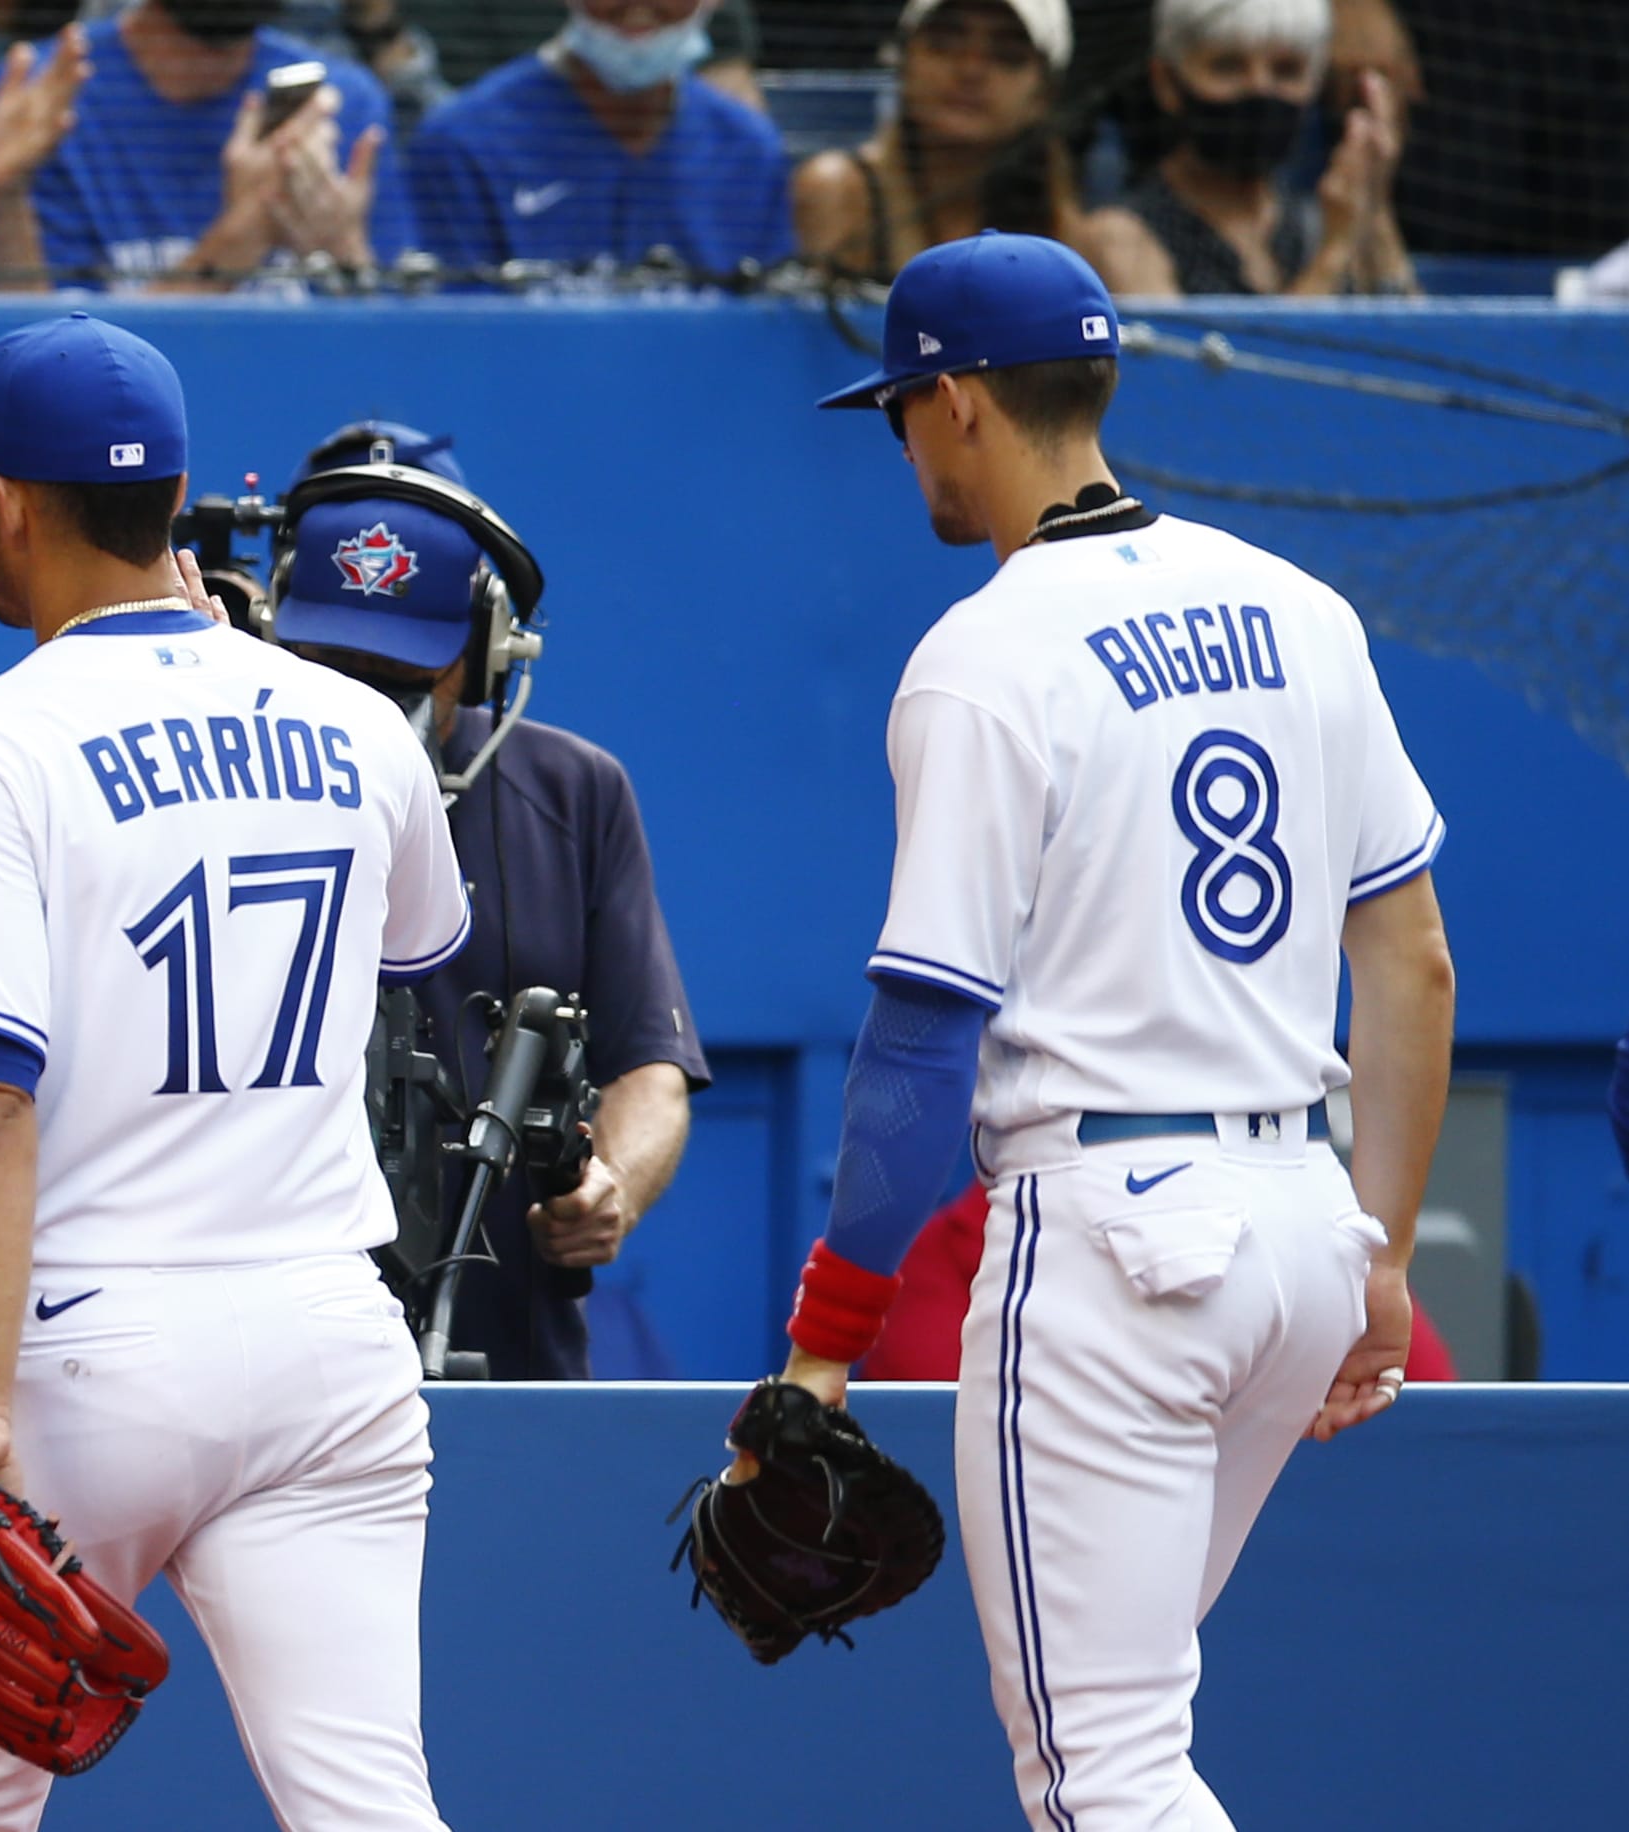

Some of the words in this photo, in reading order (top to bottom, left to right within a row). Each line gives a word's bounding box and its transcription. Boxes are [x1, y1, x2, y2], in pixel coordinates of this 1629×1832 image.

[1084, 604, 1286, 712] BIGGIO
[79, 688, 362, 824] BERRÍOS
[1171, 728, 1293, 965] 8
[122, 848, 356, 1096] 17
